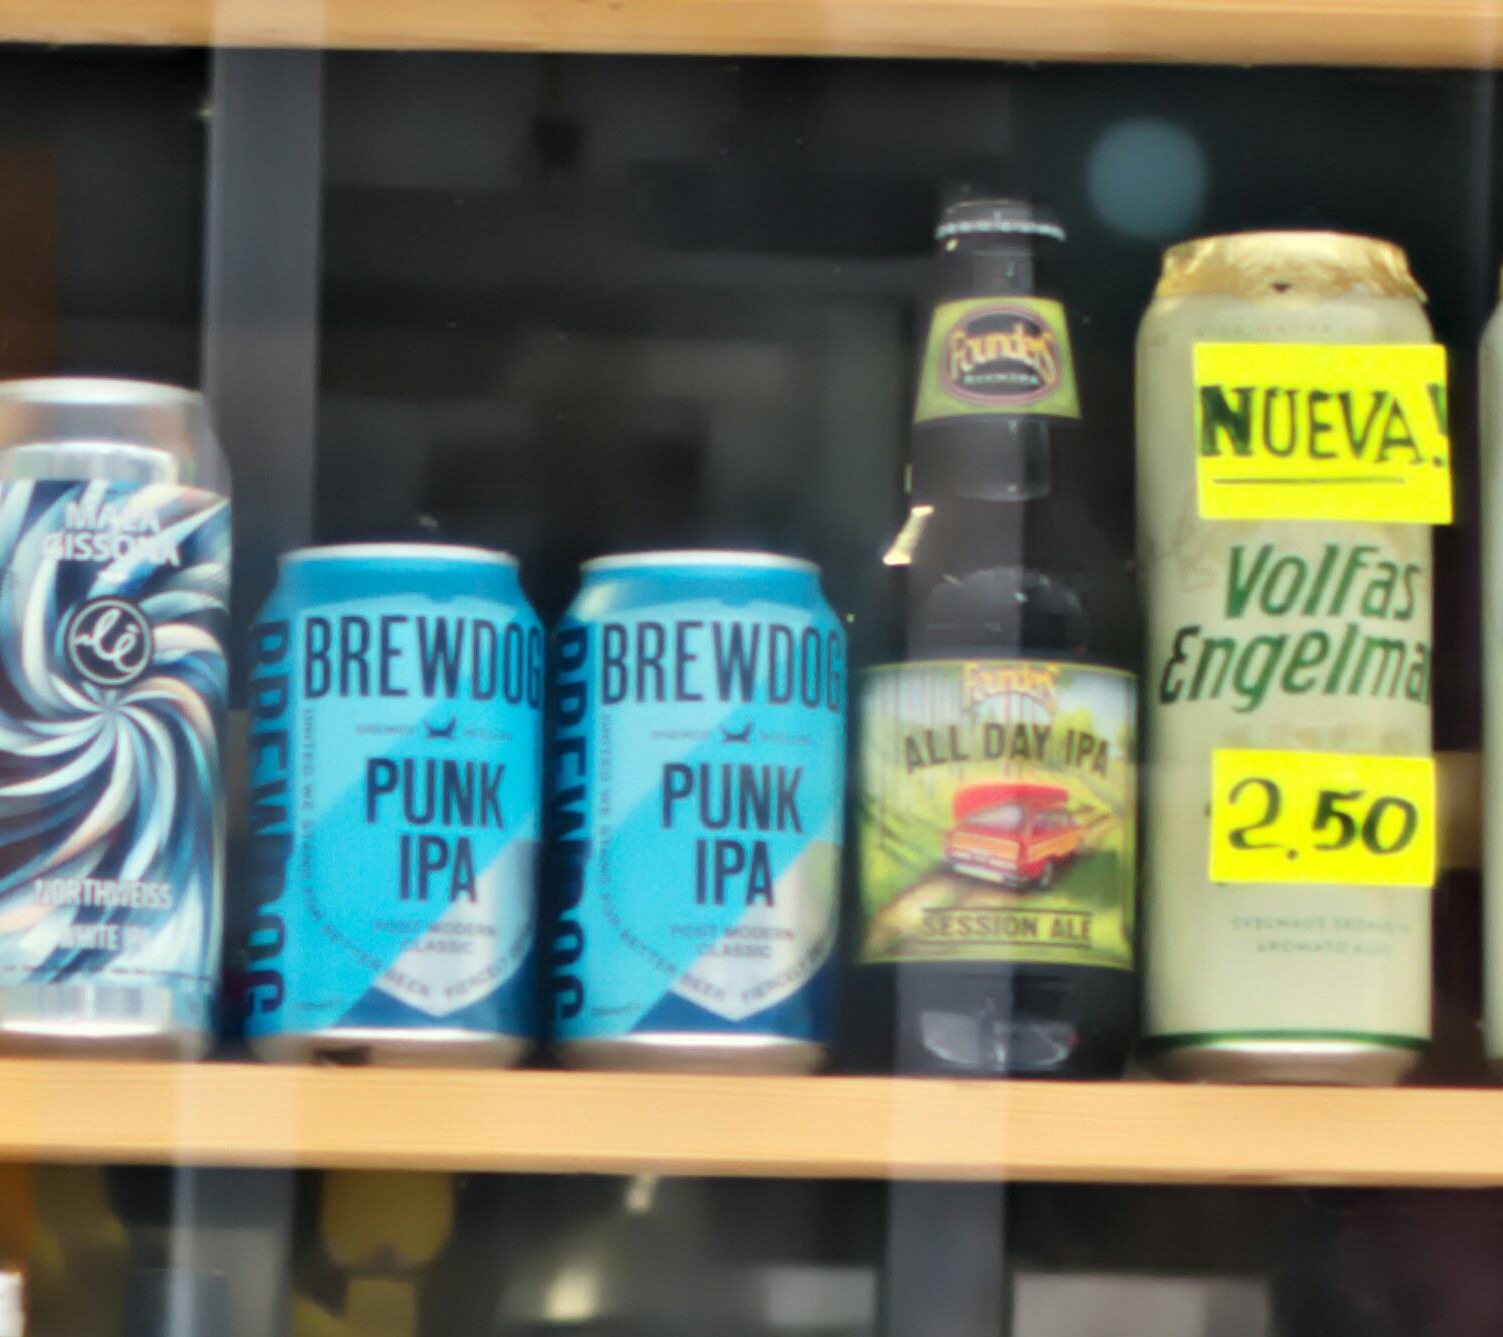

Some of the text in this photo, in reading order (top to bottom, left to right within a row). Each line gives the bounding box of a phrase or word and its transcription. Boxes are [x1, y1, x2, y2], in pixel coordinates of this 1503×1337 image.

[947, 318, 1055, 369] Founders
[1199, 382, 1449, 469] NUEVA!
[64, 503, 161, 532] MALA
[1223, 542, 1424, 623] Volfas
[304, 614, 545, 711] BREWDOG
[601, 620, 843, 714] BREWDOG
[1158, 622, 1431, 714] Engelma
[904, 721, 1109, 777] ALL DAY IPA
[365, 758, 505, 830] PUNK
[660, 761, 804, 836] PUNK
[1227, 776, 1420, 864] 2.50
[398, 833, 478, 906] IPA
[694, 837, 776, 909] IPA
[921, 911, 1092, 944] SESSION ALE
